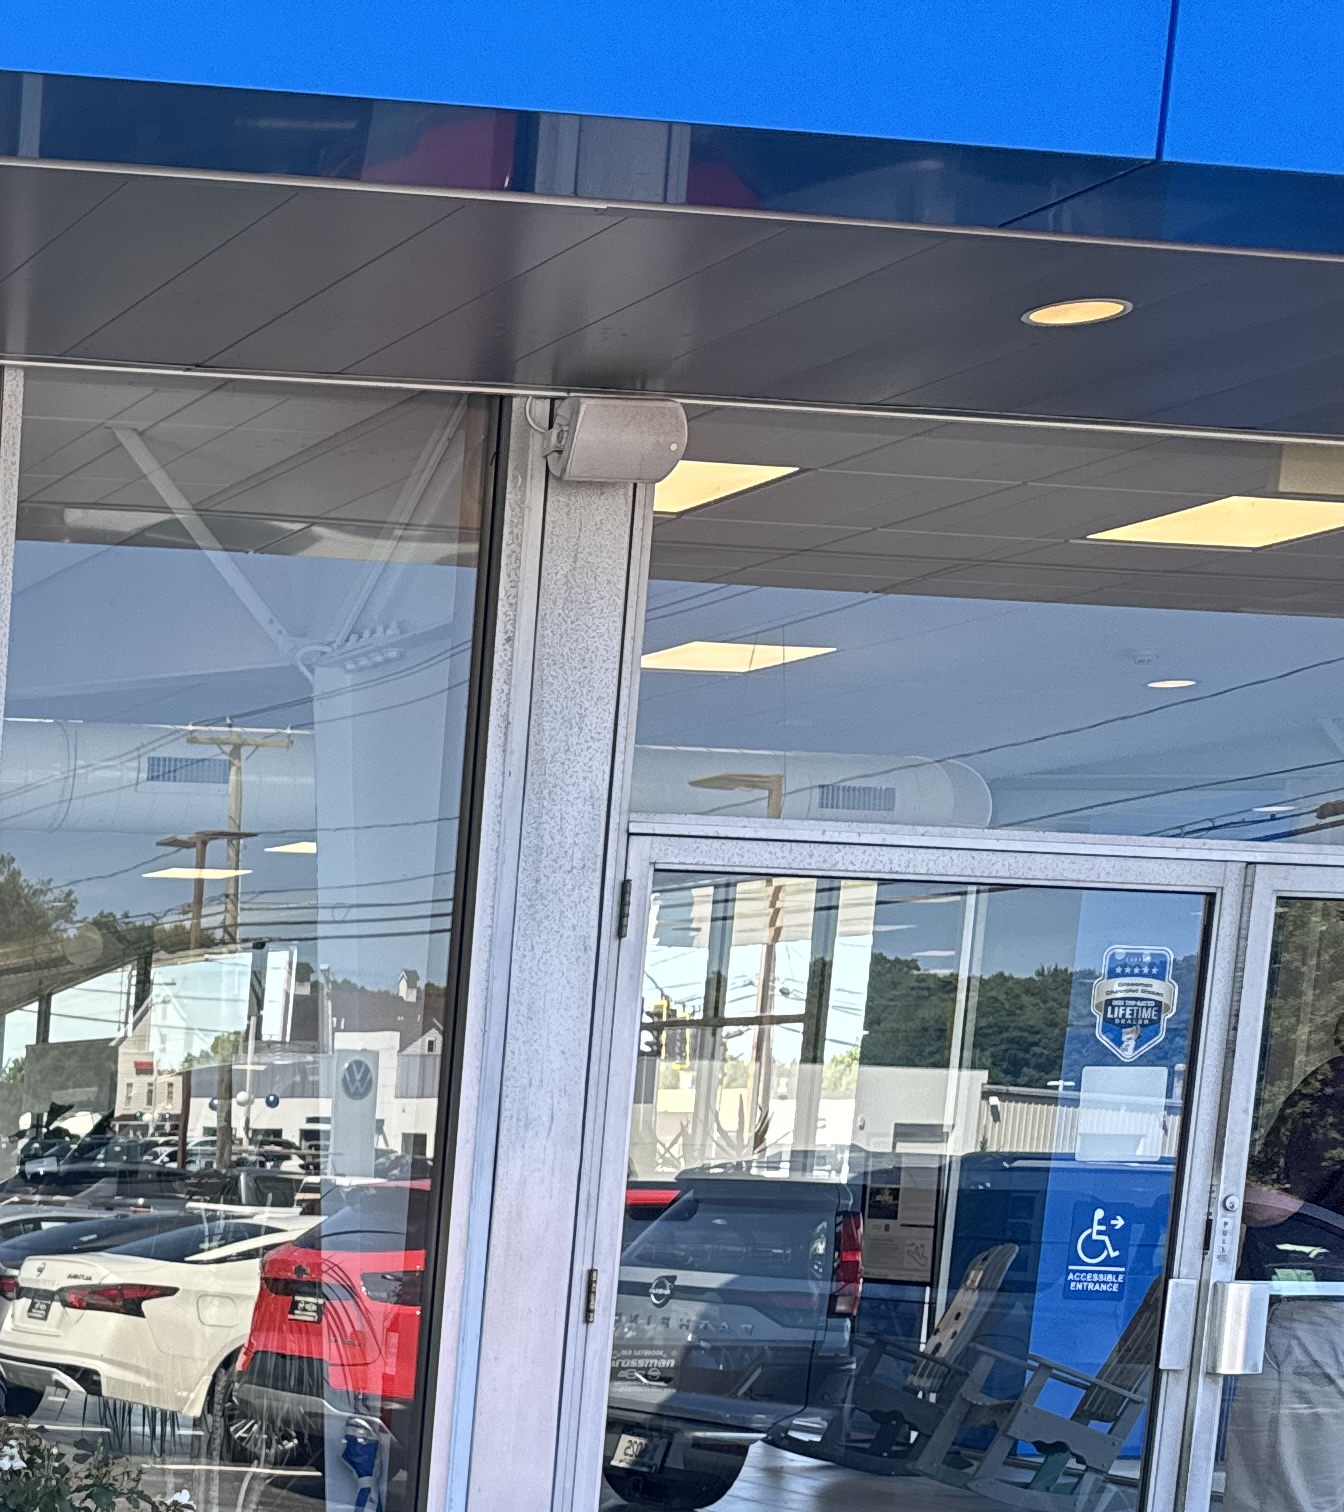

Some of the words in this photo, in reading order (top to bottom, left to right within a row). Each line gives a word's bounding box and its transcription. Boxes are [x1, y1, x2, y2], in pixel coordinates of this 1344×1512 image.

[1107, 1006, 1159, 1020] LIFETIME
[1068, 1272, 1124, 1283] ACCESSIBLE
[1070, 1281, 1119, 1293] ENTRANCE
